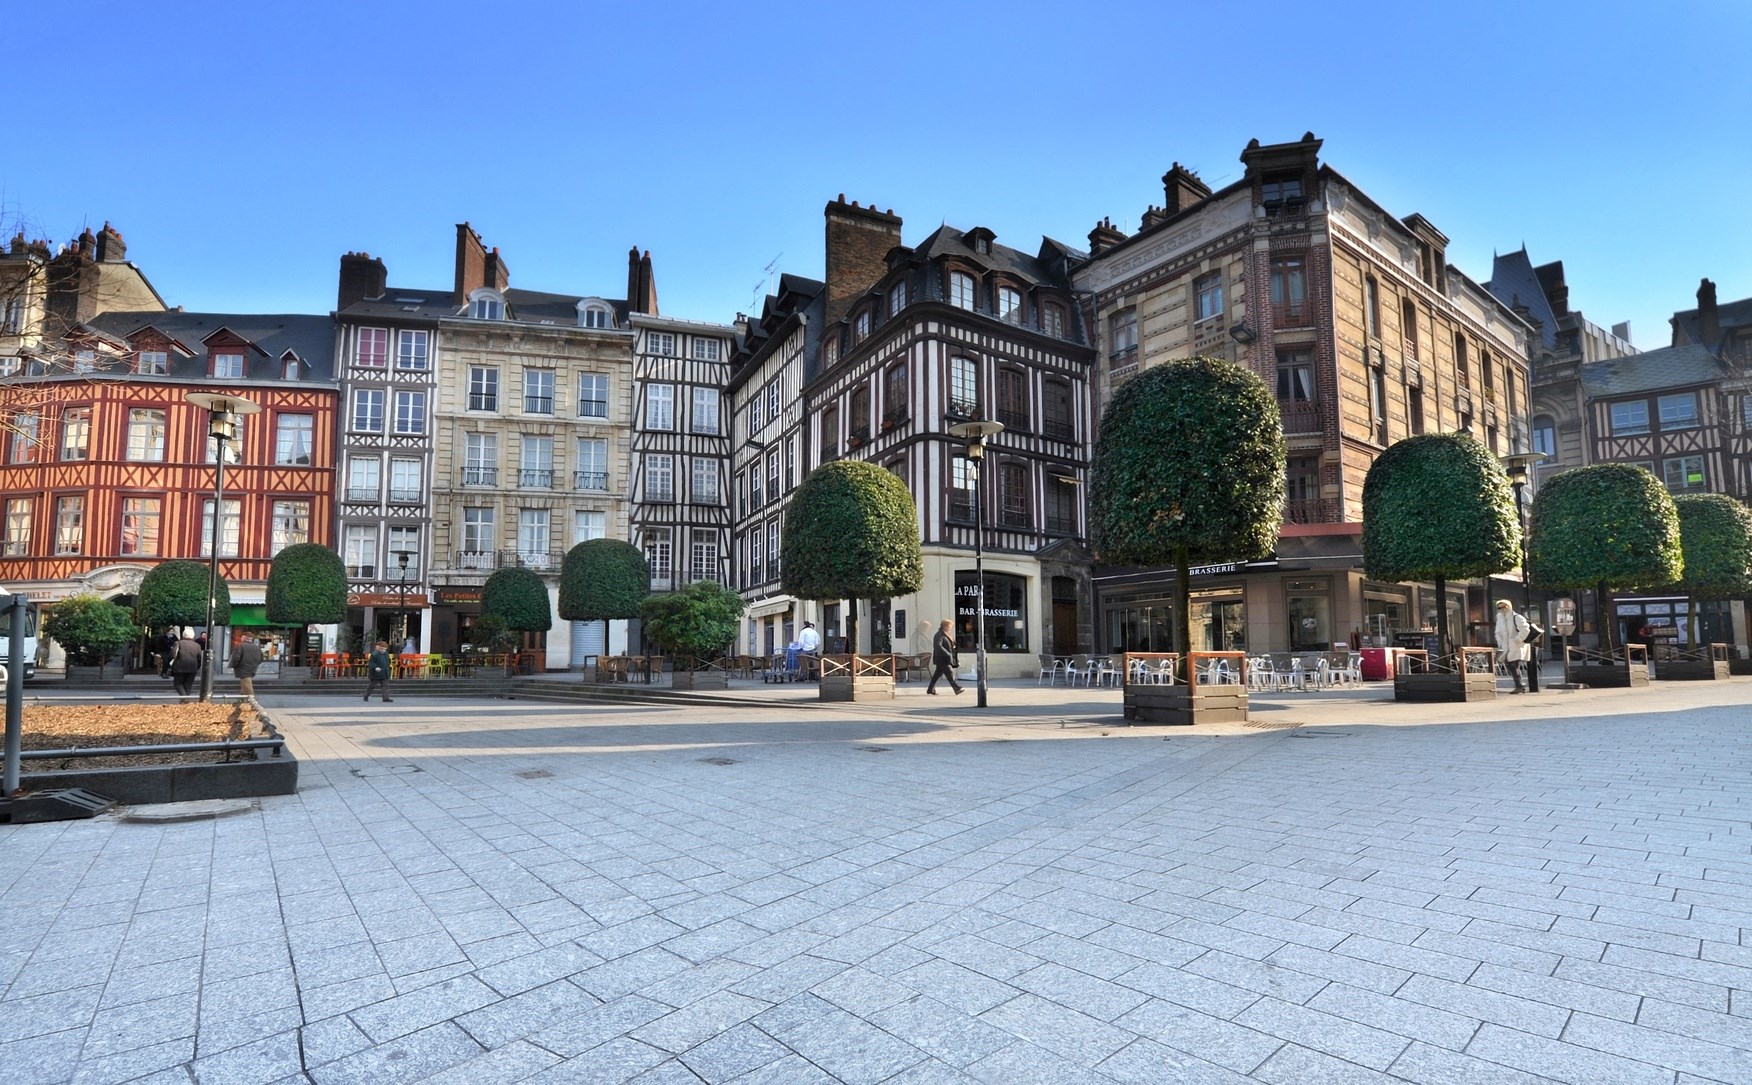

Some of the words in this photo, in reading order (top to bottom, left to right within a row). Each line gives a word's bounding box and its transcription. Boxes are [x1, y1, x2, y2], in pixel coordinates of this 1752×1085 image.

[1189, 565, 1236, 576] BRASSERIE
[25, 591, 51, 600] HELET
[963, 585, 983, 596] PAR
[959, 607, 975, 616] BAR
